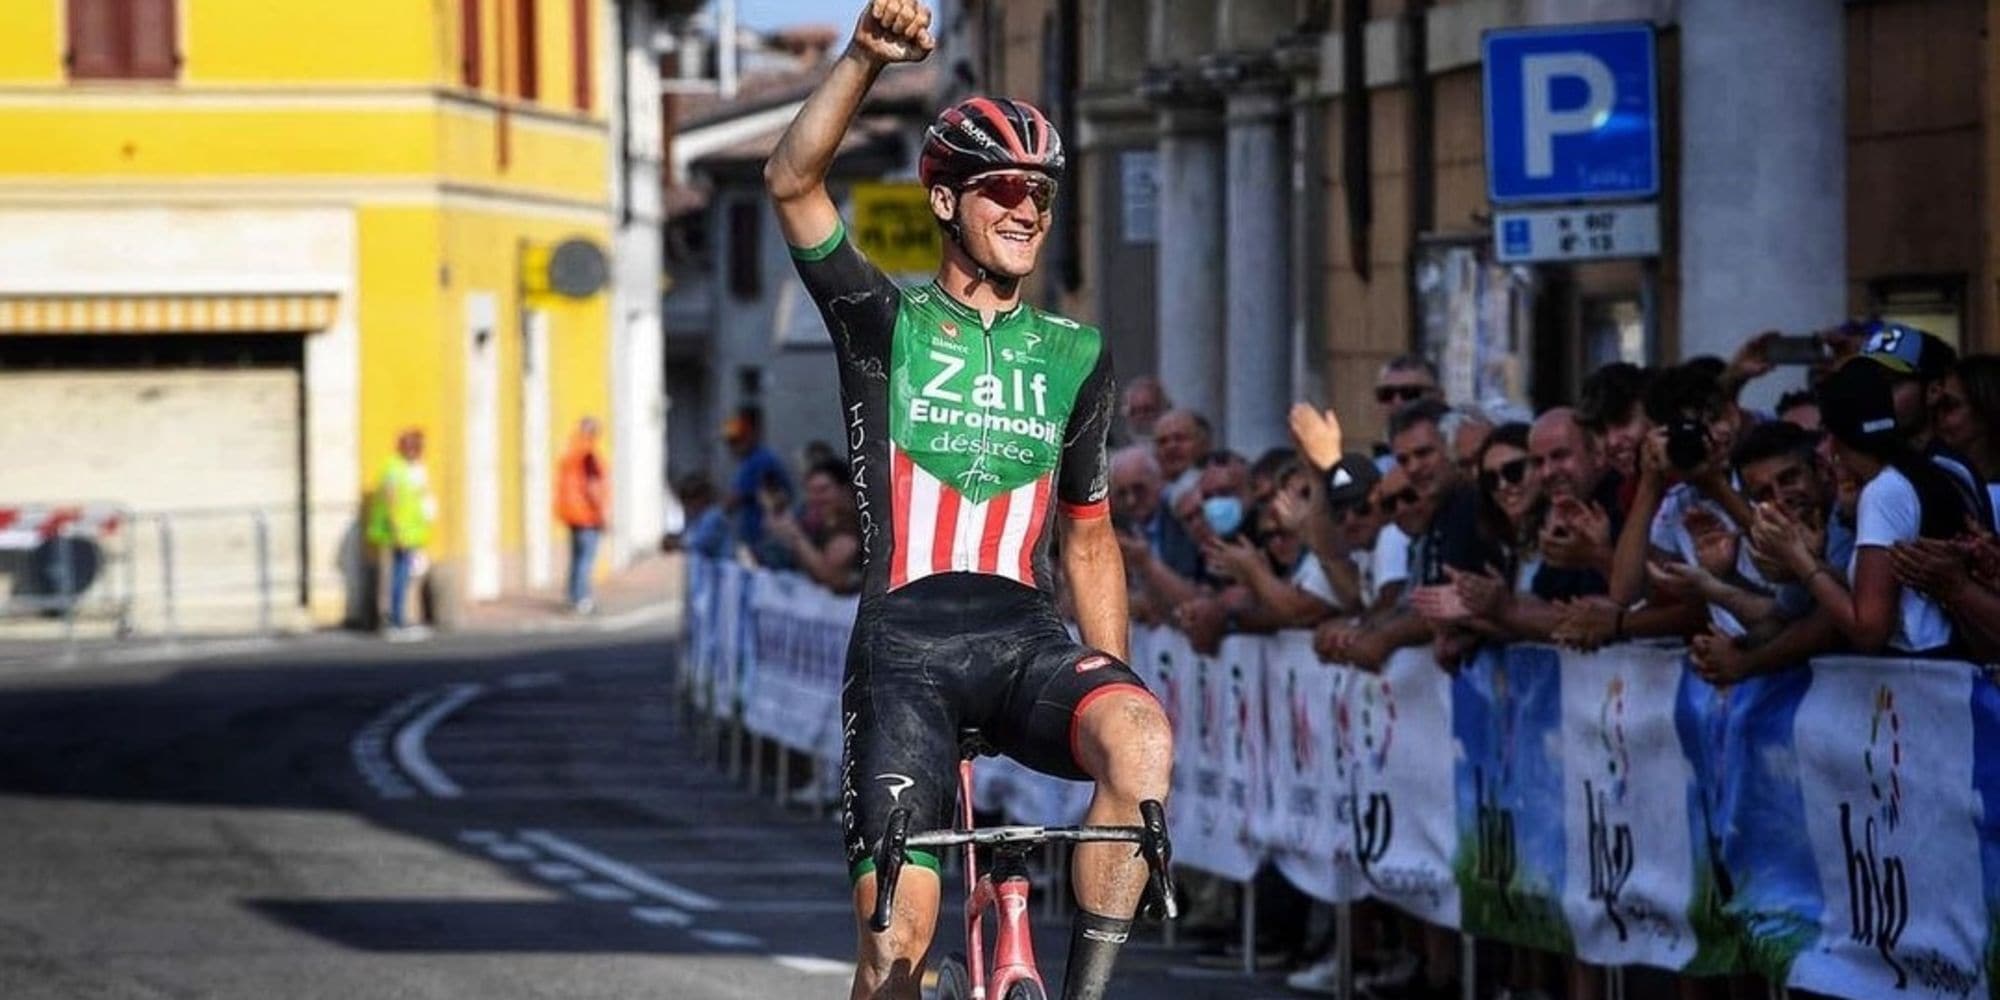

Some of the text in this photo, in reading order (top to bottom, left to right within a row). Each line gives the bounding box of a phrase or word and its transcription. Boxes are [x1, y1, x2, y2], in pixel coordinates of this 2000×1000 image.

[1521, 53, 1617, 179] P
[922, 351, 1048, 417] Zalf
[910, 398, 1056, 444] Euromobil
[930, 431, 1034, 465] désirée
